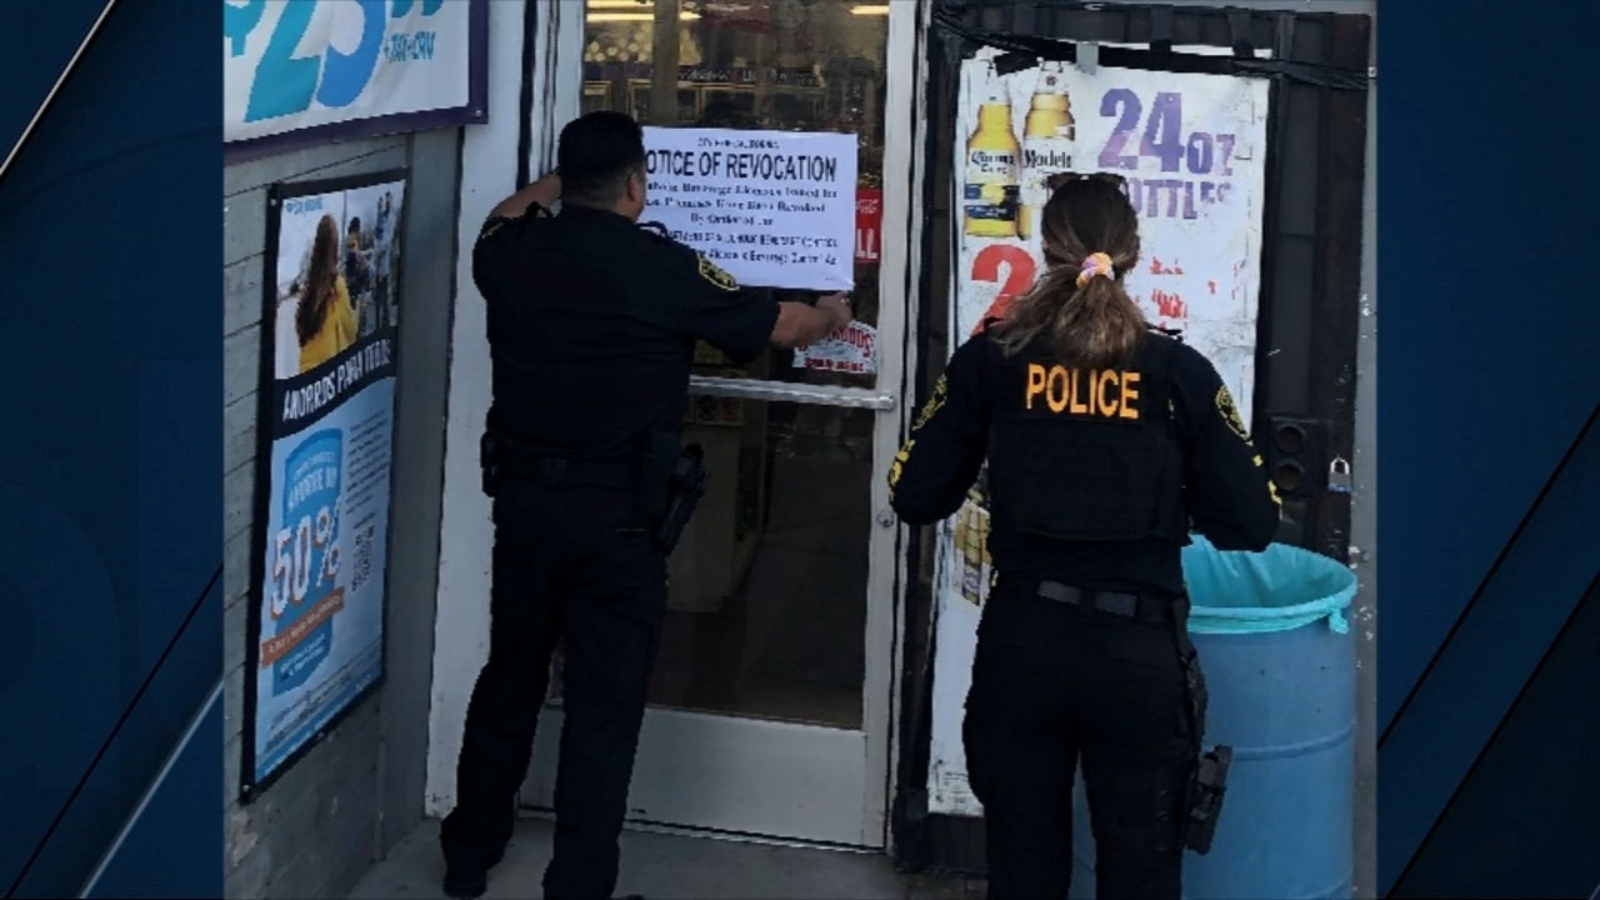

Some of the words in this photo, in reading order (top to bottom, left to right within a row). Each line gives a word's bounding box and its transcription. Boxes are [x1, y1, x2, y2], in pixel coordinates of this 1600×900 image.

[645, 150, 695, 177] OTICE
[699, 151, 722, 177] OF
[726, 153, 837, 182] REVOCATION
[1025, 363, 1142, 420] POLICE
[270, 495, 342, 620] 50%
